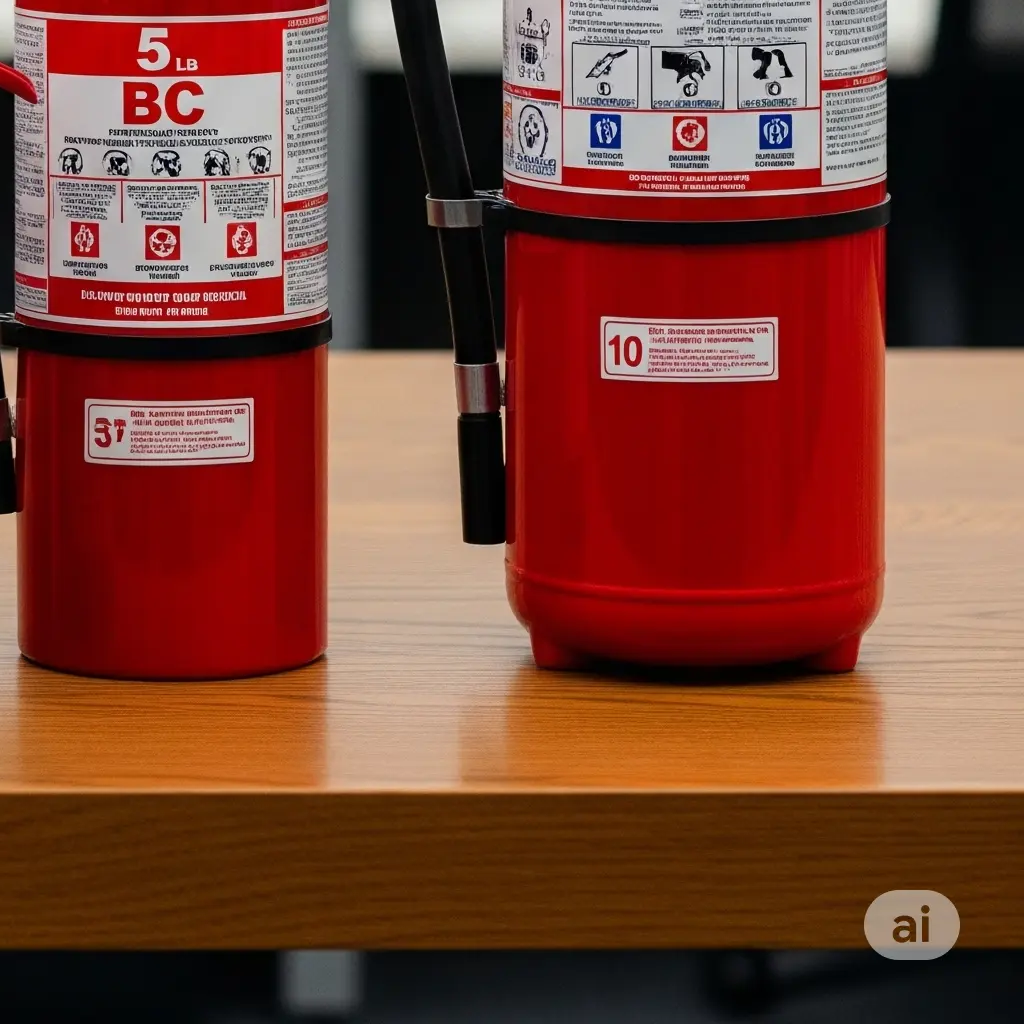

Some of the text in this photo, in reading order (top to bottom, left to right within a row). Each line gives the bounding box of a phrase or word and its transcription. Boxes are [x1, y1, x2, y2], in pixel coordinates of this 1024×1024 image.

[136, 27, 199, 72] 5 LB
[122, 80, 205, 126] BC
[608, 334, 643, 368] 10
